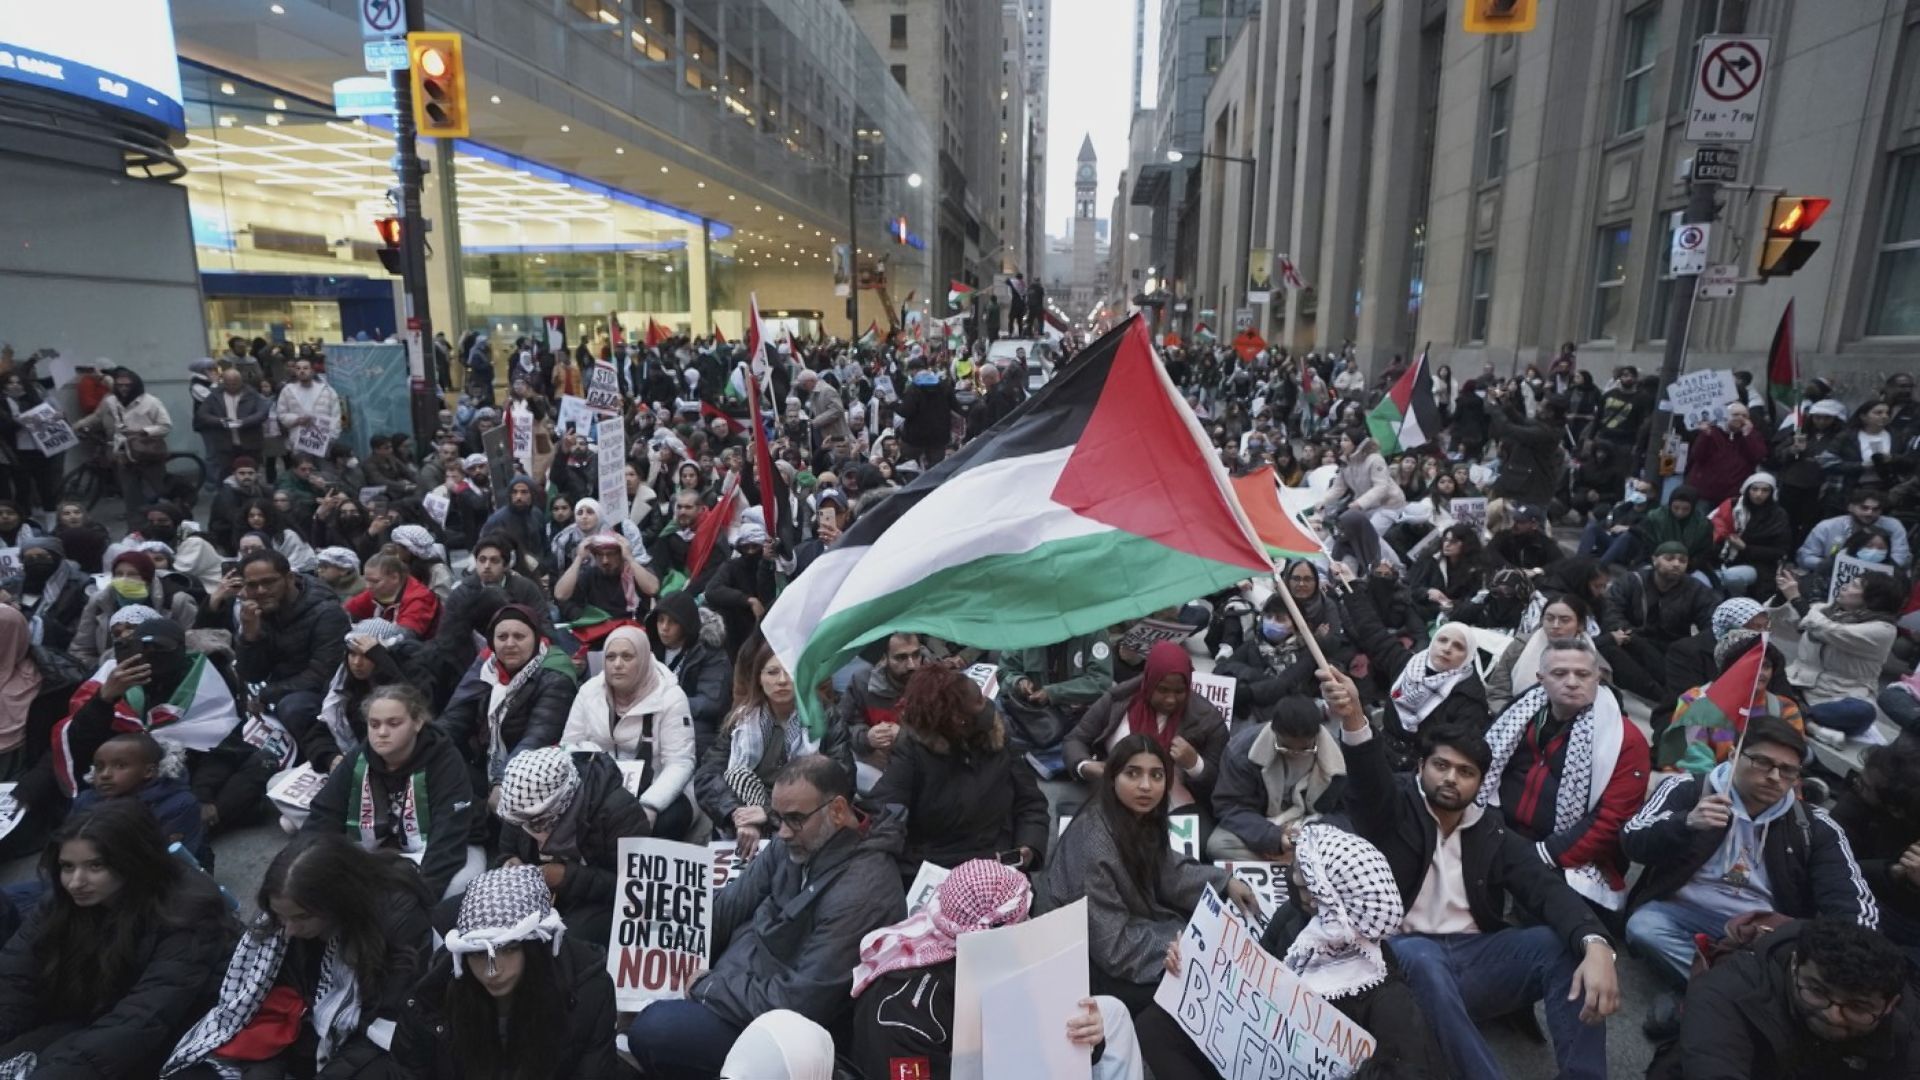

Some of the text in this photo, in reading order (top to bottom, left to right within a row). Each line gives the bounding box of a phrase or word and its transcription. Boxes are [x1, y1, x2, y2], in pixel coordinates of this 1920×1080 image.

[590, 391, 618, 408] GAZA
[1208, 685, 1229, 703] THE
[626, 852, 667, 881] END
[673, 858, 708, 890] THE
[623, 880, 707, 930] SIEGE
[618, 919, 706, 958] ON GAZA
[1190, 923, 1207, 952] TO
[1211, 947, 1307, 1065] PALESTINE
[1220, 910, 1284, 1001] TURTLE
[1289, 984, 1372, 1070] ISLAND
[1177, 957, 1234, 1070] BE
